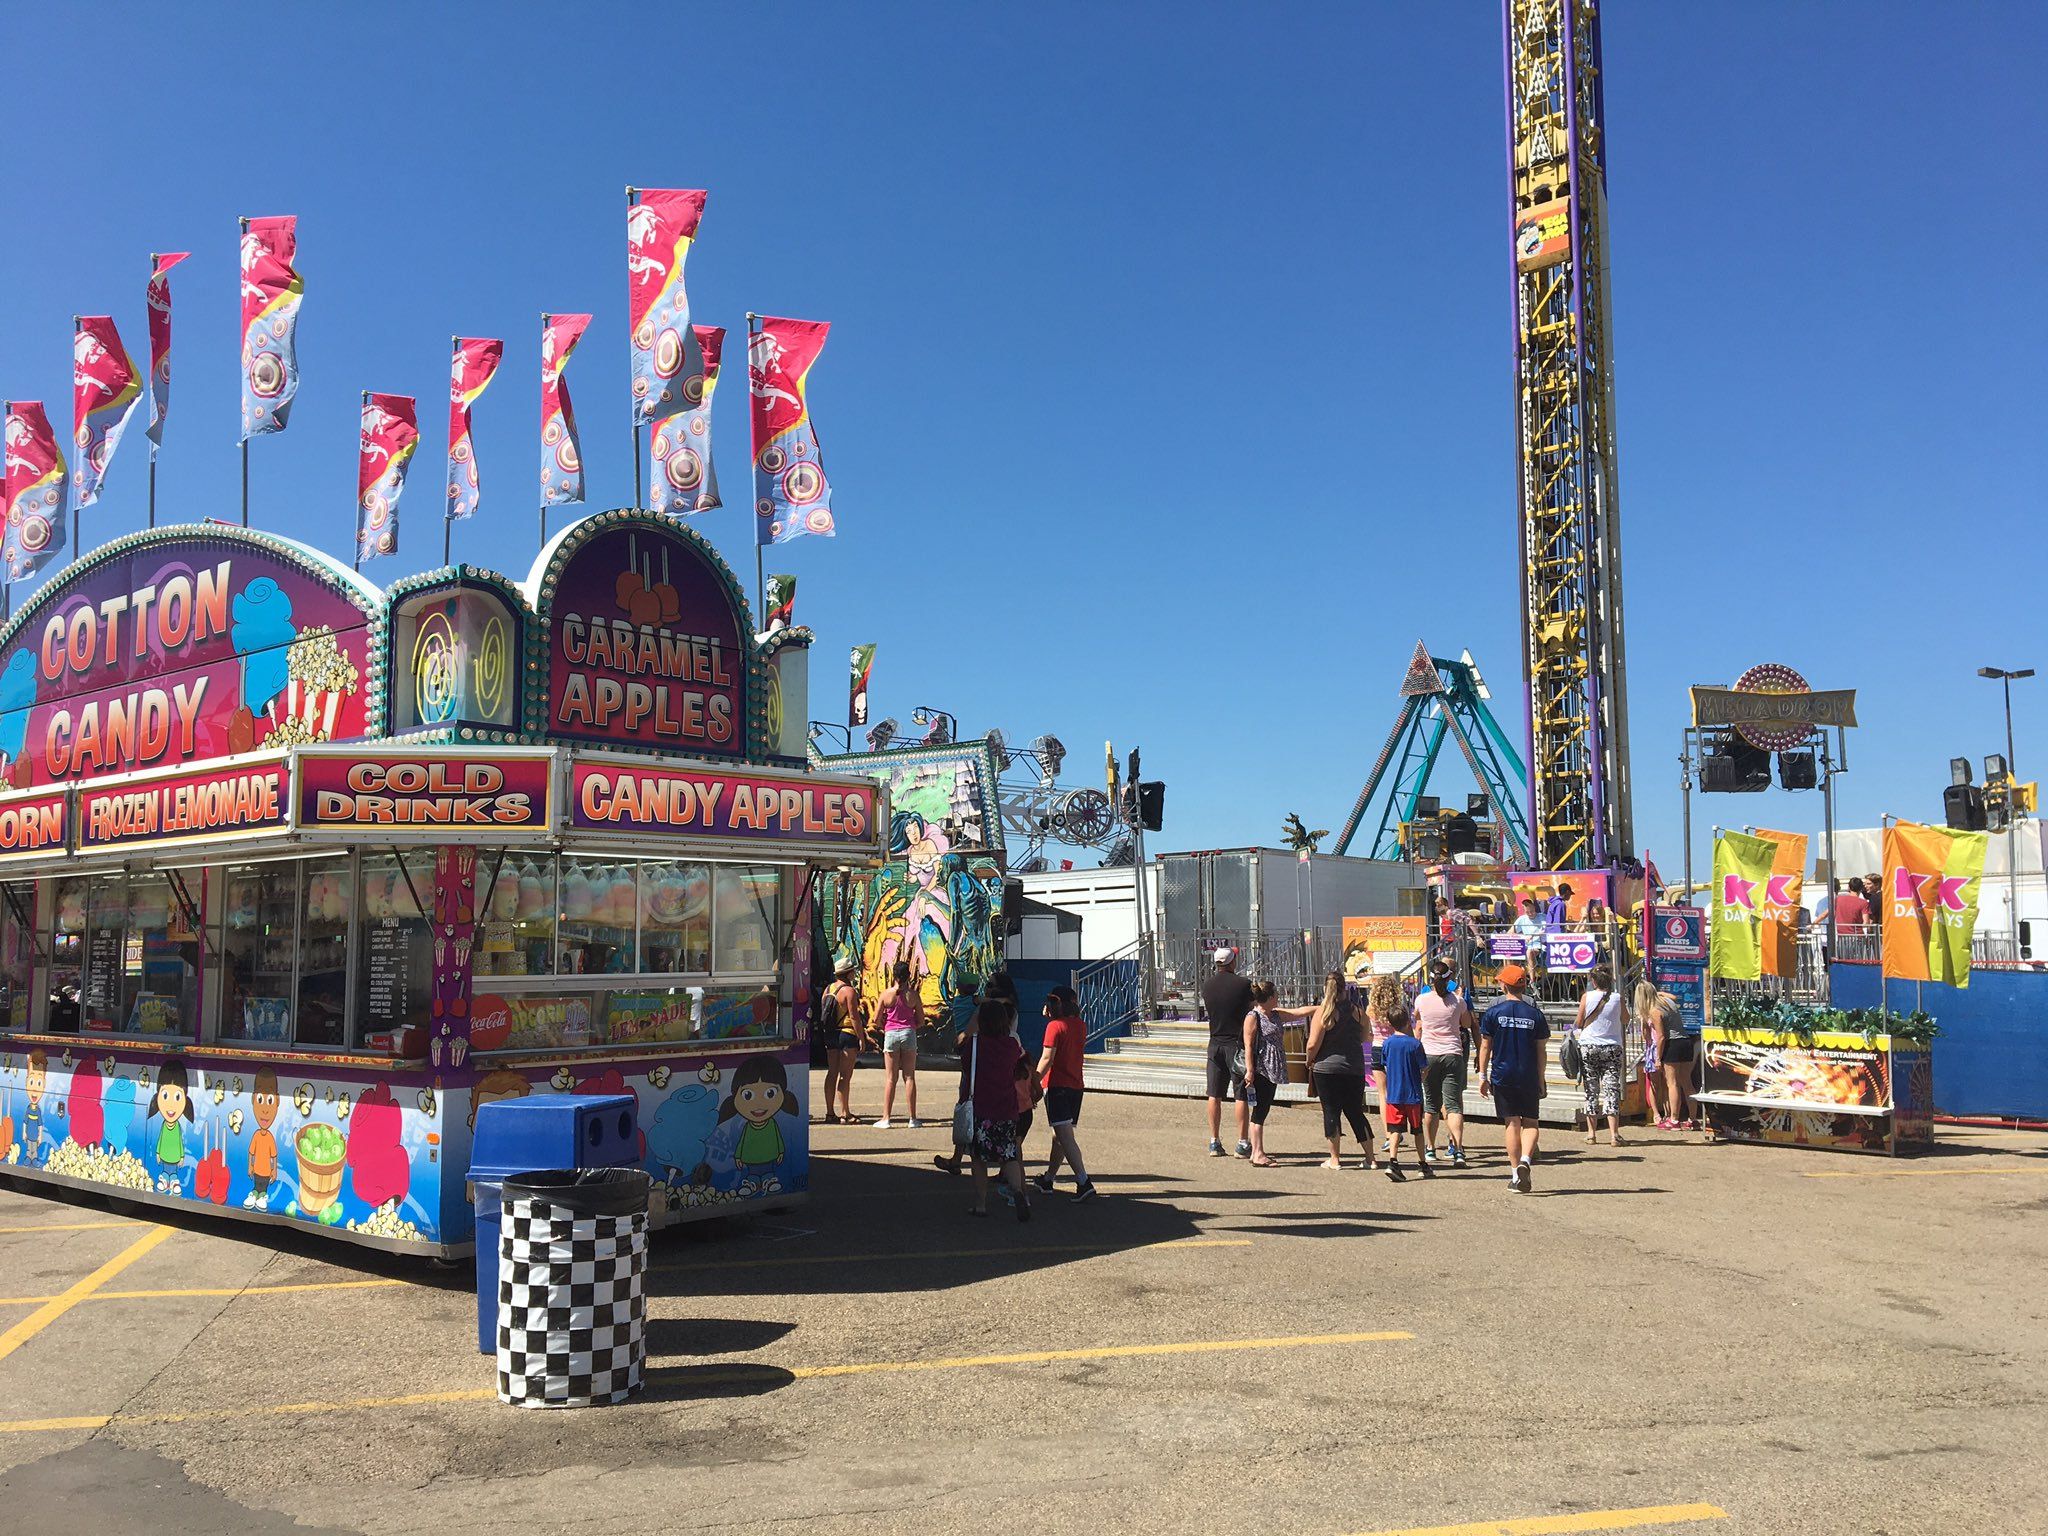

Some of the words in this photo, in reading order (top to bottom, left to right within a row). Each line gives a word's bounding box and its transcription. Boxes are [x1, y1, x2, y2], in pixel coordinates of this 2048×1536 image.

[41, 560, 231, 680] COTTON
[562, 613, 730, 686] CARAMEL
[558, 673, 732, 742] APPLES
[1700, 695, 1771, 720] MEGA
[1777, 696, 1850, 721] DROP
[45, 676, 209, 776] CANDY
[347, 763, 503, 793] COLD
[89, 790, 160, 841] FROZEN
[162, 773, 279, 832] LEMONADE
[316, 790, 532, 823] DRINKS
[581, 773, 724, 827] CANDY
[728, 784, 866, 836] APPLES
[382, 917, 399, 927] MENU
[1671, 919, 1682, 935] 6
[1550, 944, 1571, 956] NO
[1550, 957, 1571, 965] HATS
[611, 1001, 687, 1042] LEMNADE
[1813, 1049, 1877, 1060] ENTERTAINMENT
